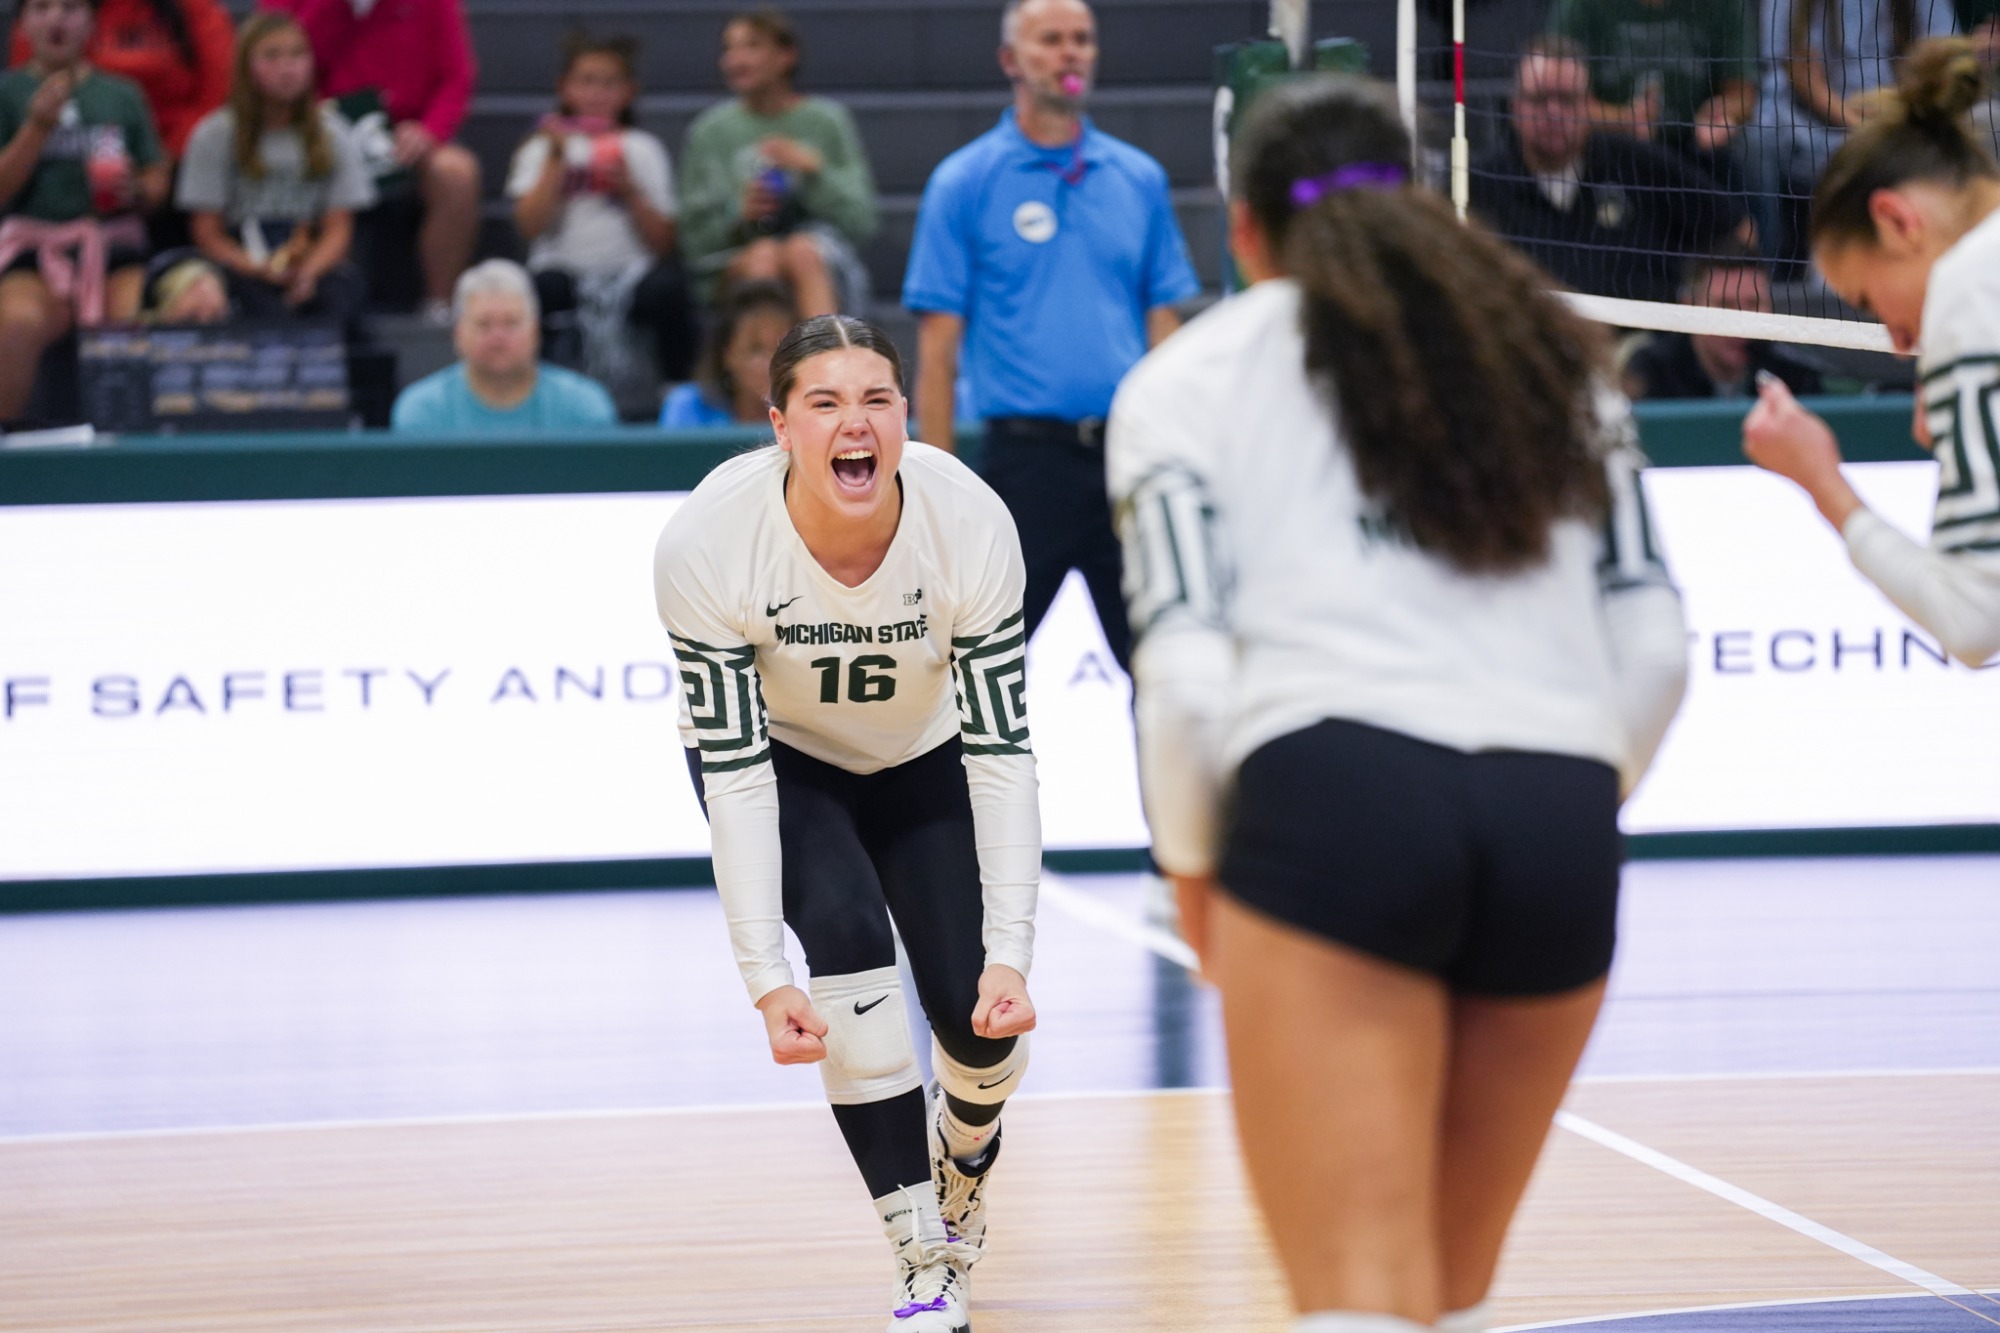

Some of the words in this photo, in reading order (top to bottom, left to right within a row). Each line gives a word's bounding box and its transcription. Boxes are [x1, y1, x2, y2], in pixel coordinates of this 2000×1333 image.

[775, 622, 873, 646] MICHIGAN
[89, 668, 450, 718] SAFETY
[490, 663, 673, 703] AND
[1688, 627, 2000, 675] ECHN
[810, 654, 897, 704] 16
